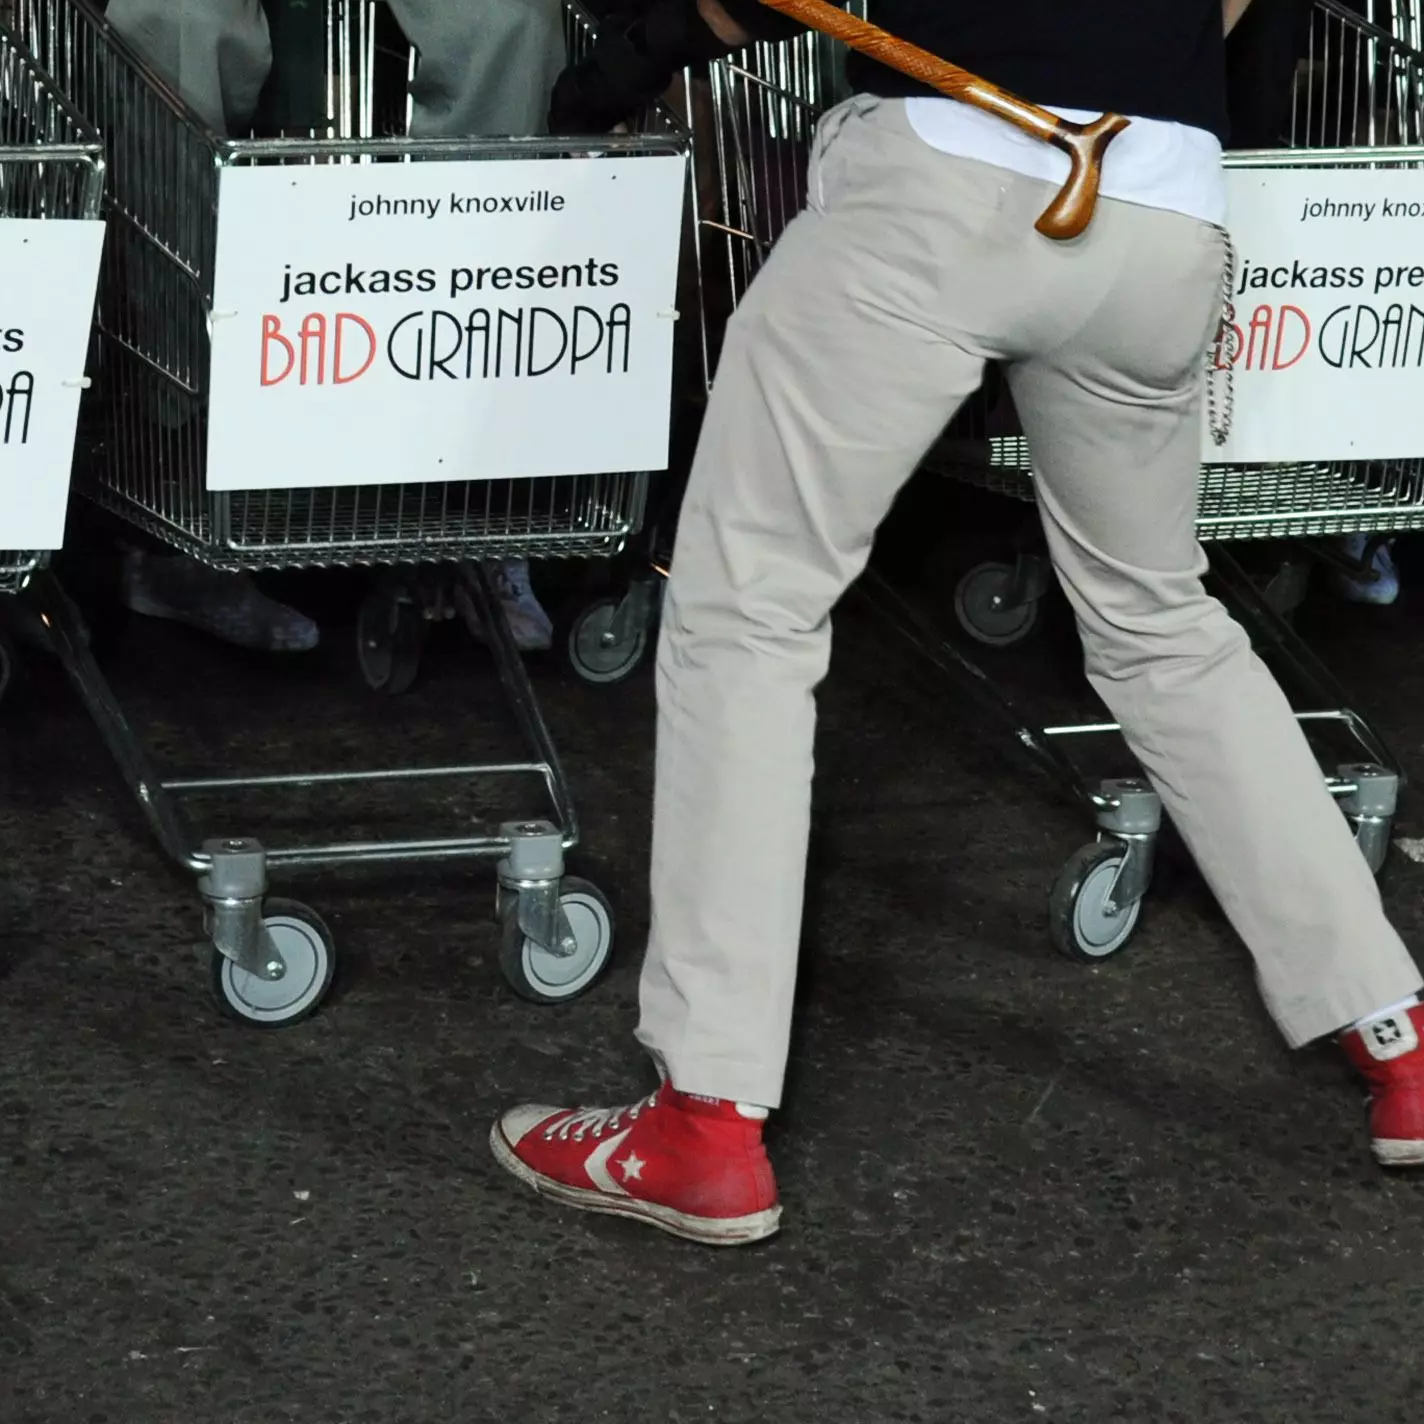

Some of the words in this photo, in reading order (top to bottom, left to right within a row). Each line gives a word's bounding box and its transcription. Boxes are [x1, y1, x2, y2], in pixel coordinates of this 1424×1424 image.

[348, 194, 441, 221] johnny
[450, 190, 565, 213] knoxville
[1300, 198, 1376, 222] johnny
[280, 263, 436, 303] jackass
[450, 258, 619, 298] presents
[1236, 260, 1364, 295] jackass
[260, 313, 376, 386] BAD
[387, 302, 631, 380] GRANDPA
[1214, 304, 1312, 371] BAD
